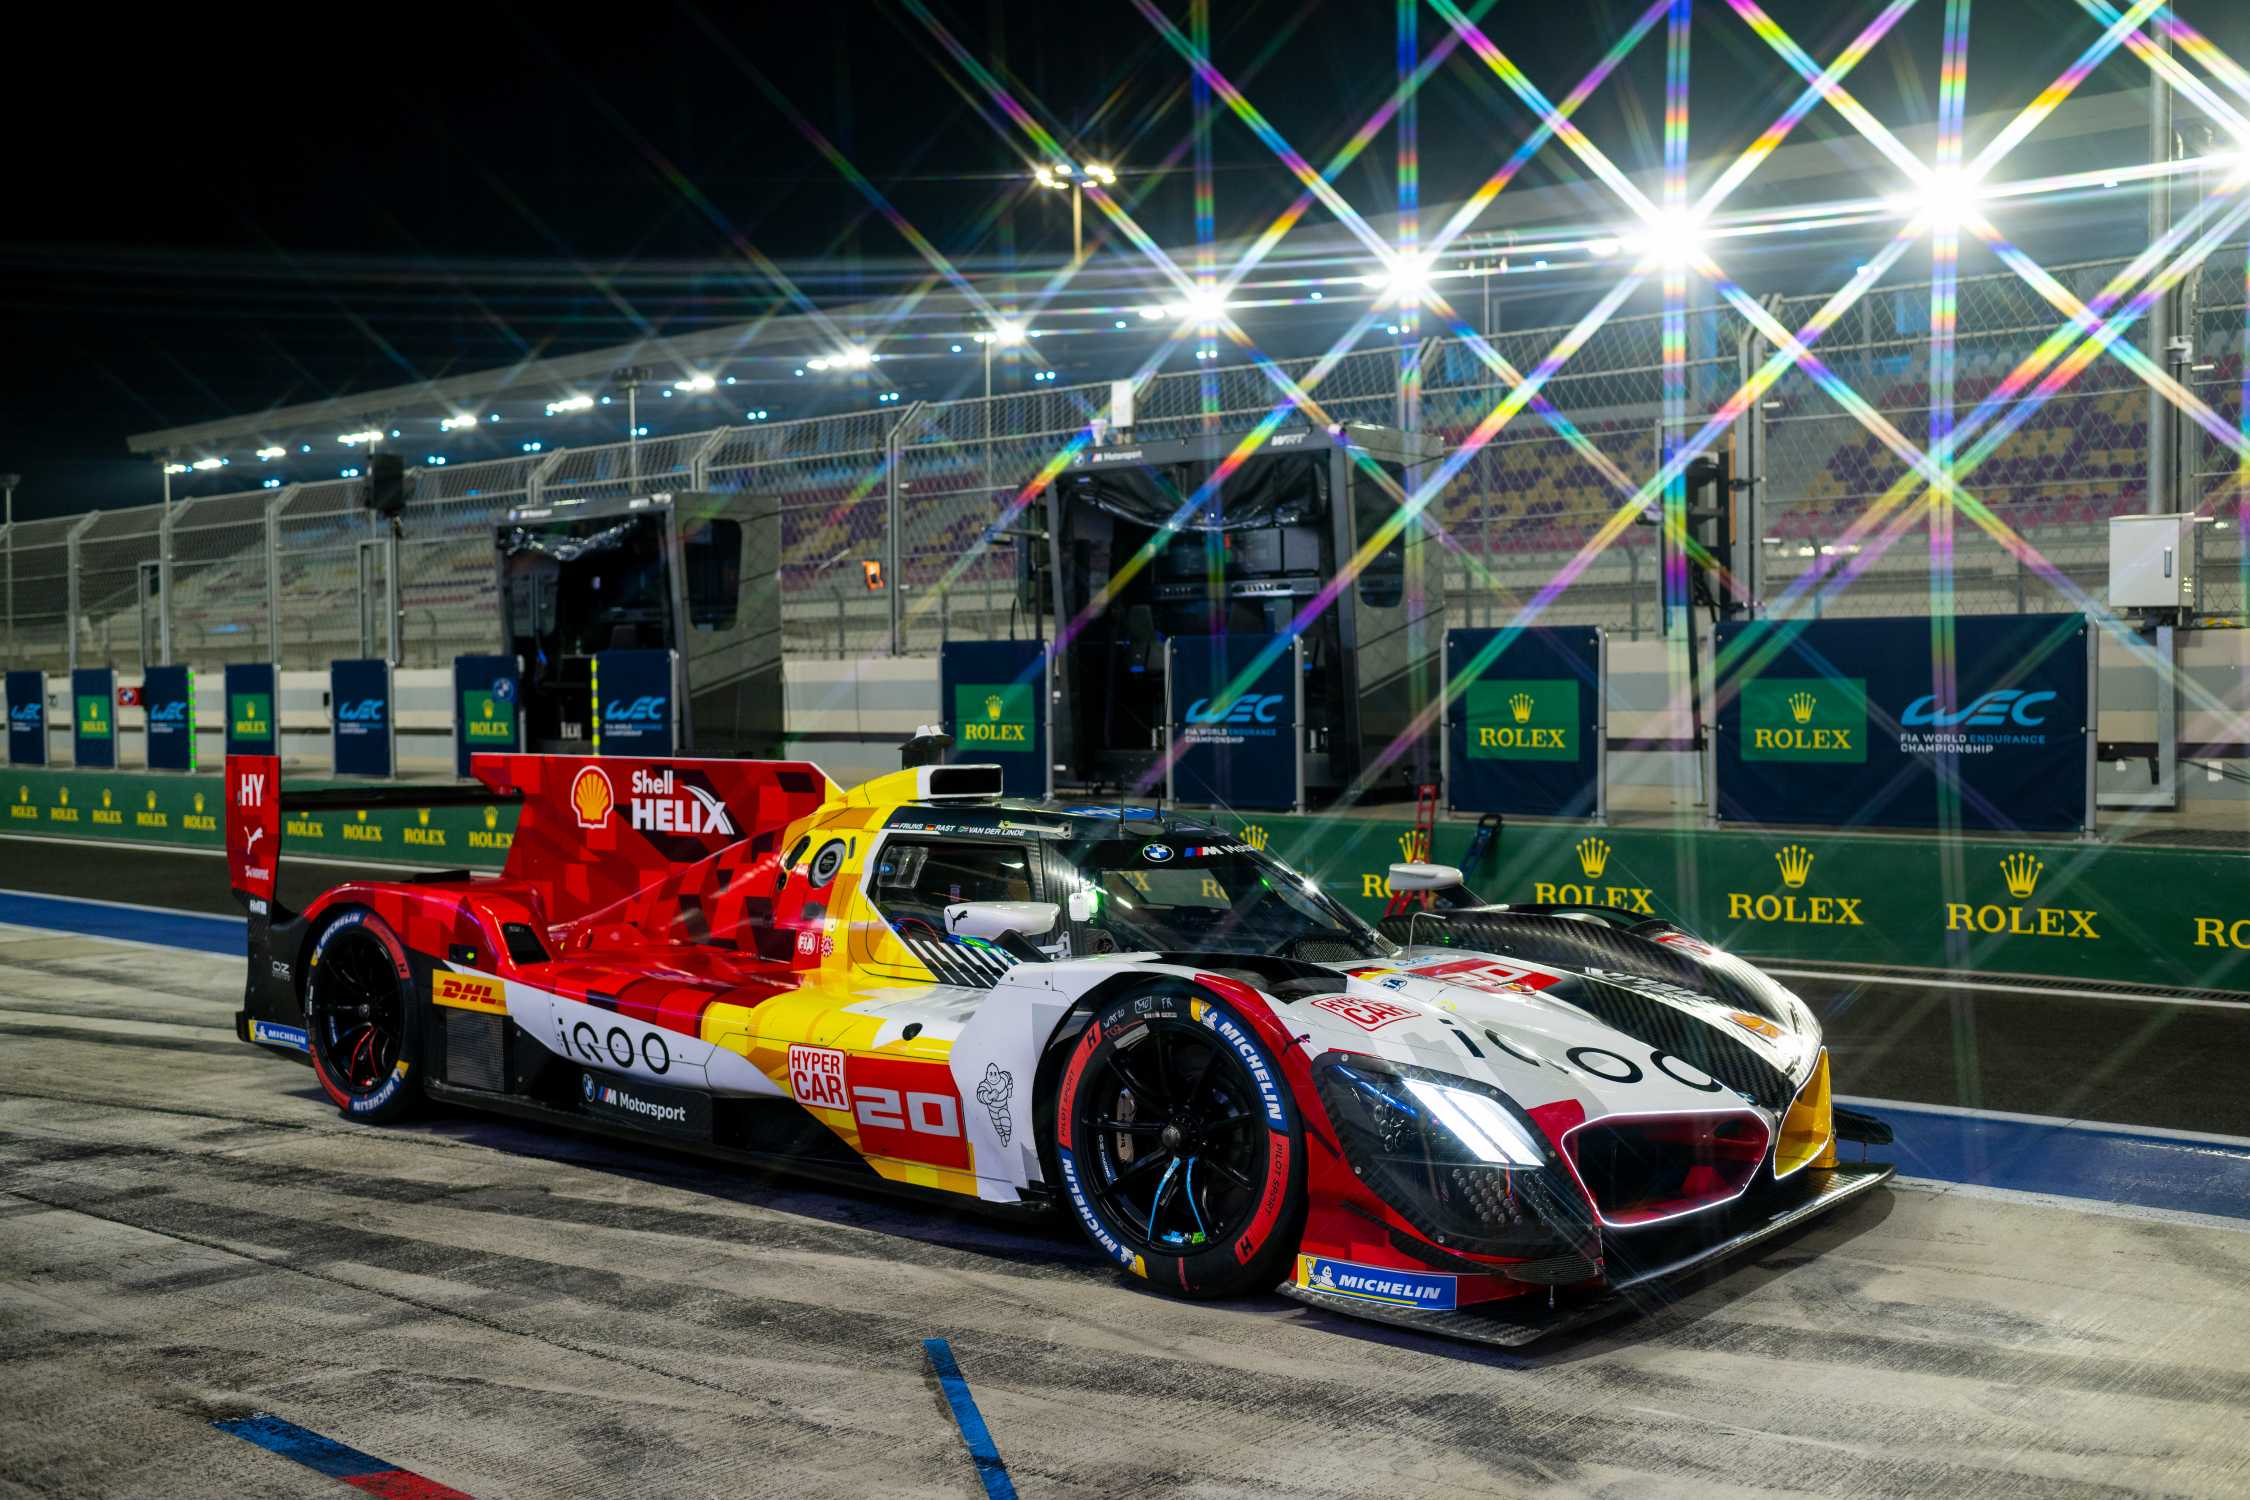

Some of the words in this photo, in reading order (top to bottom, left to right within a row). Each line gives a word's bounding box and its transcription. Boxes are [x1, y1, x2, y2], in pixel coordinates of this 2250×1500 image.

[338, 699, 384, 720] WEC
[604, 696, 666, 720] WEC
[1185, 694, 1283, 723] WEC
[1901, 689, 2057, 726] WEC
[470, 722, 508, 736] ROLEX
[965, 724, 1025, 742] ROLEX
[1184, 735, 1245, 743] CHAMPIONSHIP
[1479, 727, 1566, 750] ROLEX
[1754, 728, 1852, 750] ROLEX
[1900, 733, 1919, 743] FIA
[1922, 733, 1967, 743] WORLD
[1969, 734, 2046, 745] ENDURANCE
[1900, 743, 1994, 754] CHAMPIONSHIP
[241, 773, 264, 807] HY
[631, 769, 674, 795] Shell
[183, 814, 216, 831] ROLEX
[631, 796, 735, 835] HELIX
[287, 820, 324, 838] ROLEX
[343, 824, 382, 842] ROLEX
[403, 827, 446, 846] ROLEX
[468, 831, 513, 848] ROLEX
[968, 826, 984, 834] VAN
[984, 827, 1001, 835] DER
[1001, 829, 1026, 837] LINDE
[1535, 882, 1656, 914] ROLEX
[1728, 893, 1865, 926] ROLEX
[320, 911, 361, 947] MICHELIN
[1946, 903, 2100, 940] ROLEX
[272, 960, 290, 975] OZ
[442, 979, 497, 1006] DHL
[1343, 1001, 1410, 1026] CAR
[268, 1029, 306, 1044] MICHELIN
[1086, 1029, 1097, 1050] H
[791, 1049, 840, 1075] HYPER
[1218, 1020, 1282, 1121] MICHELIN
[352, 1082, 396, 1111] MICHELIN
[793, 1070, 846, 1106] CAR
[619, 1093, 686, 1122] Motorsport
[851, 1085, 960, 1137] 20
[1274, 1142, 1283, 1176] PILOT
[1062, 1158, 1117, 1253] MICHELIN
[1338, 1274, 1441, 1300] MICHELIN
